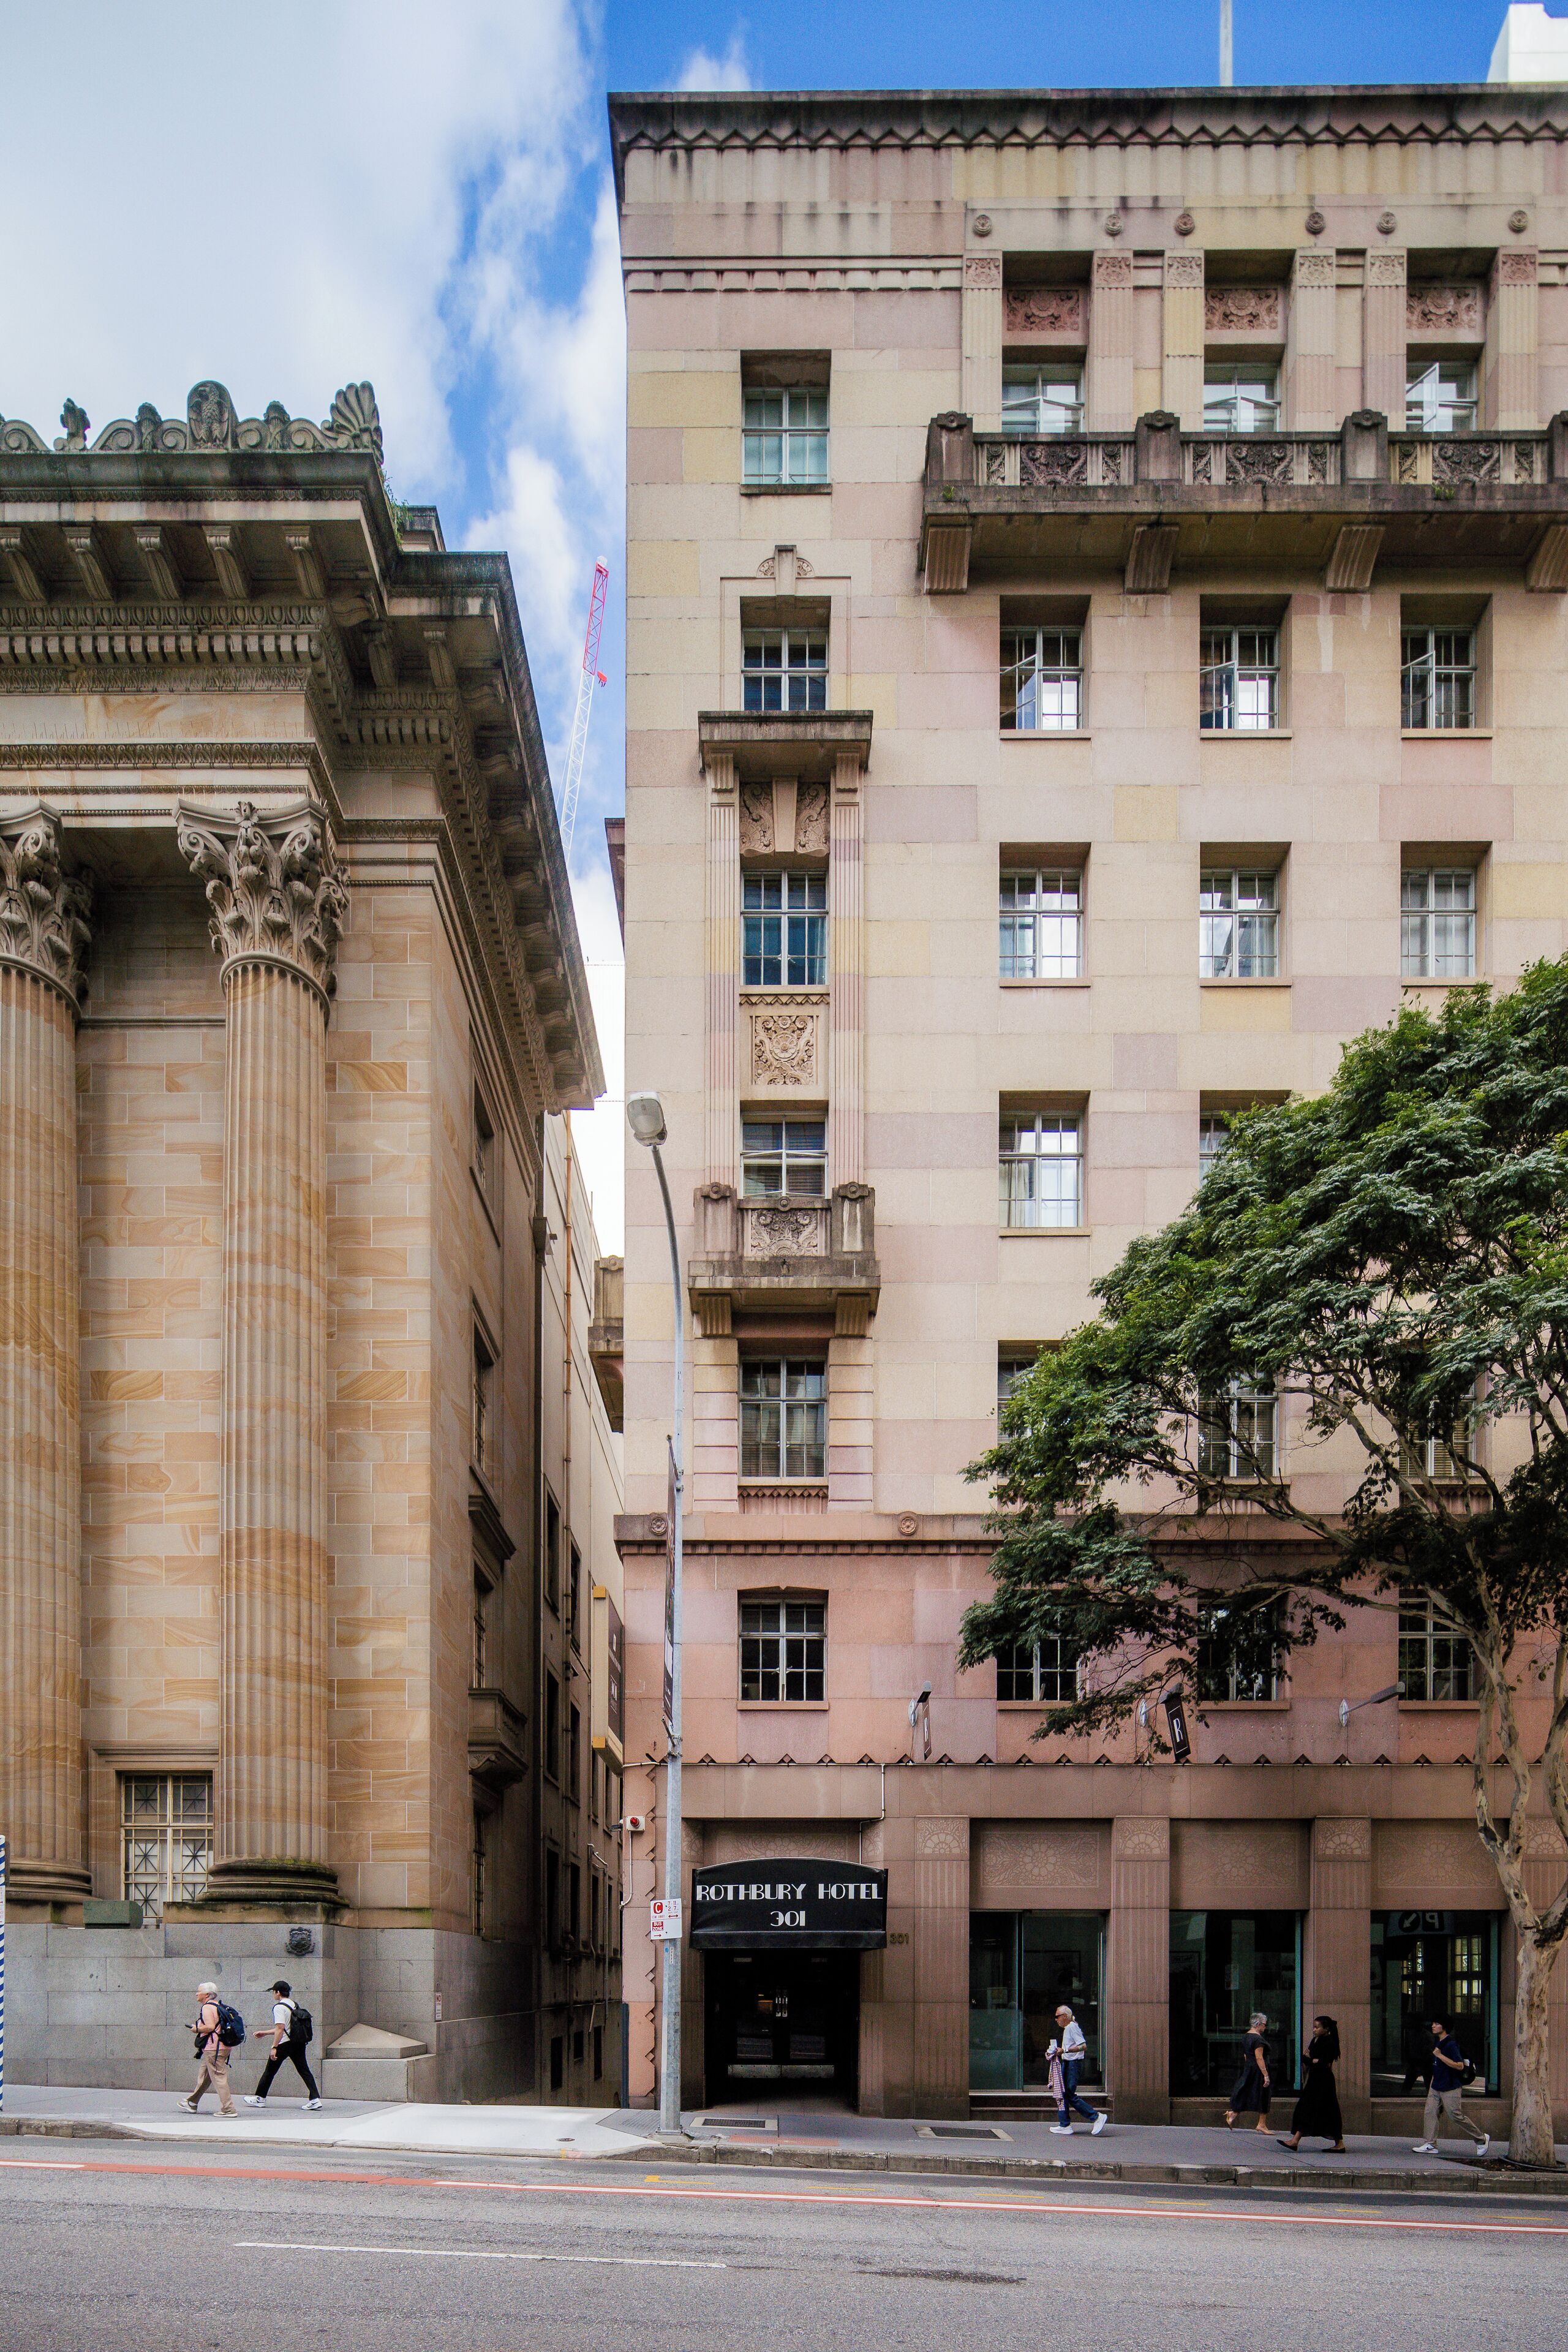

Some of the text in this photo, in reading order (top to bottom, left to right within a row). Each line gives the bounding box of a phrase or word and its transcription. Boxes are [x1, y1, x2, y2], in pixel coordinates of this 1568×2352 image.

[924, 1717, 929, 1742] R
[1173, 1718, 1183, 1743] R
[696, 1883, 883, 1901] ROTHBURY HOTEL
[655, 1902, 662, 1913] C
[770, 1910, 806, 1926] 301
[890, 1932, 909, 1943] 301
